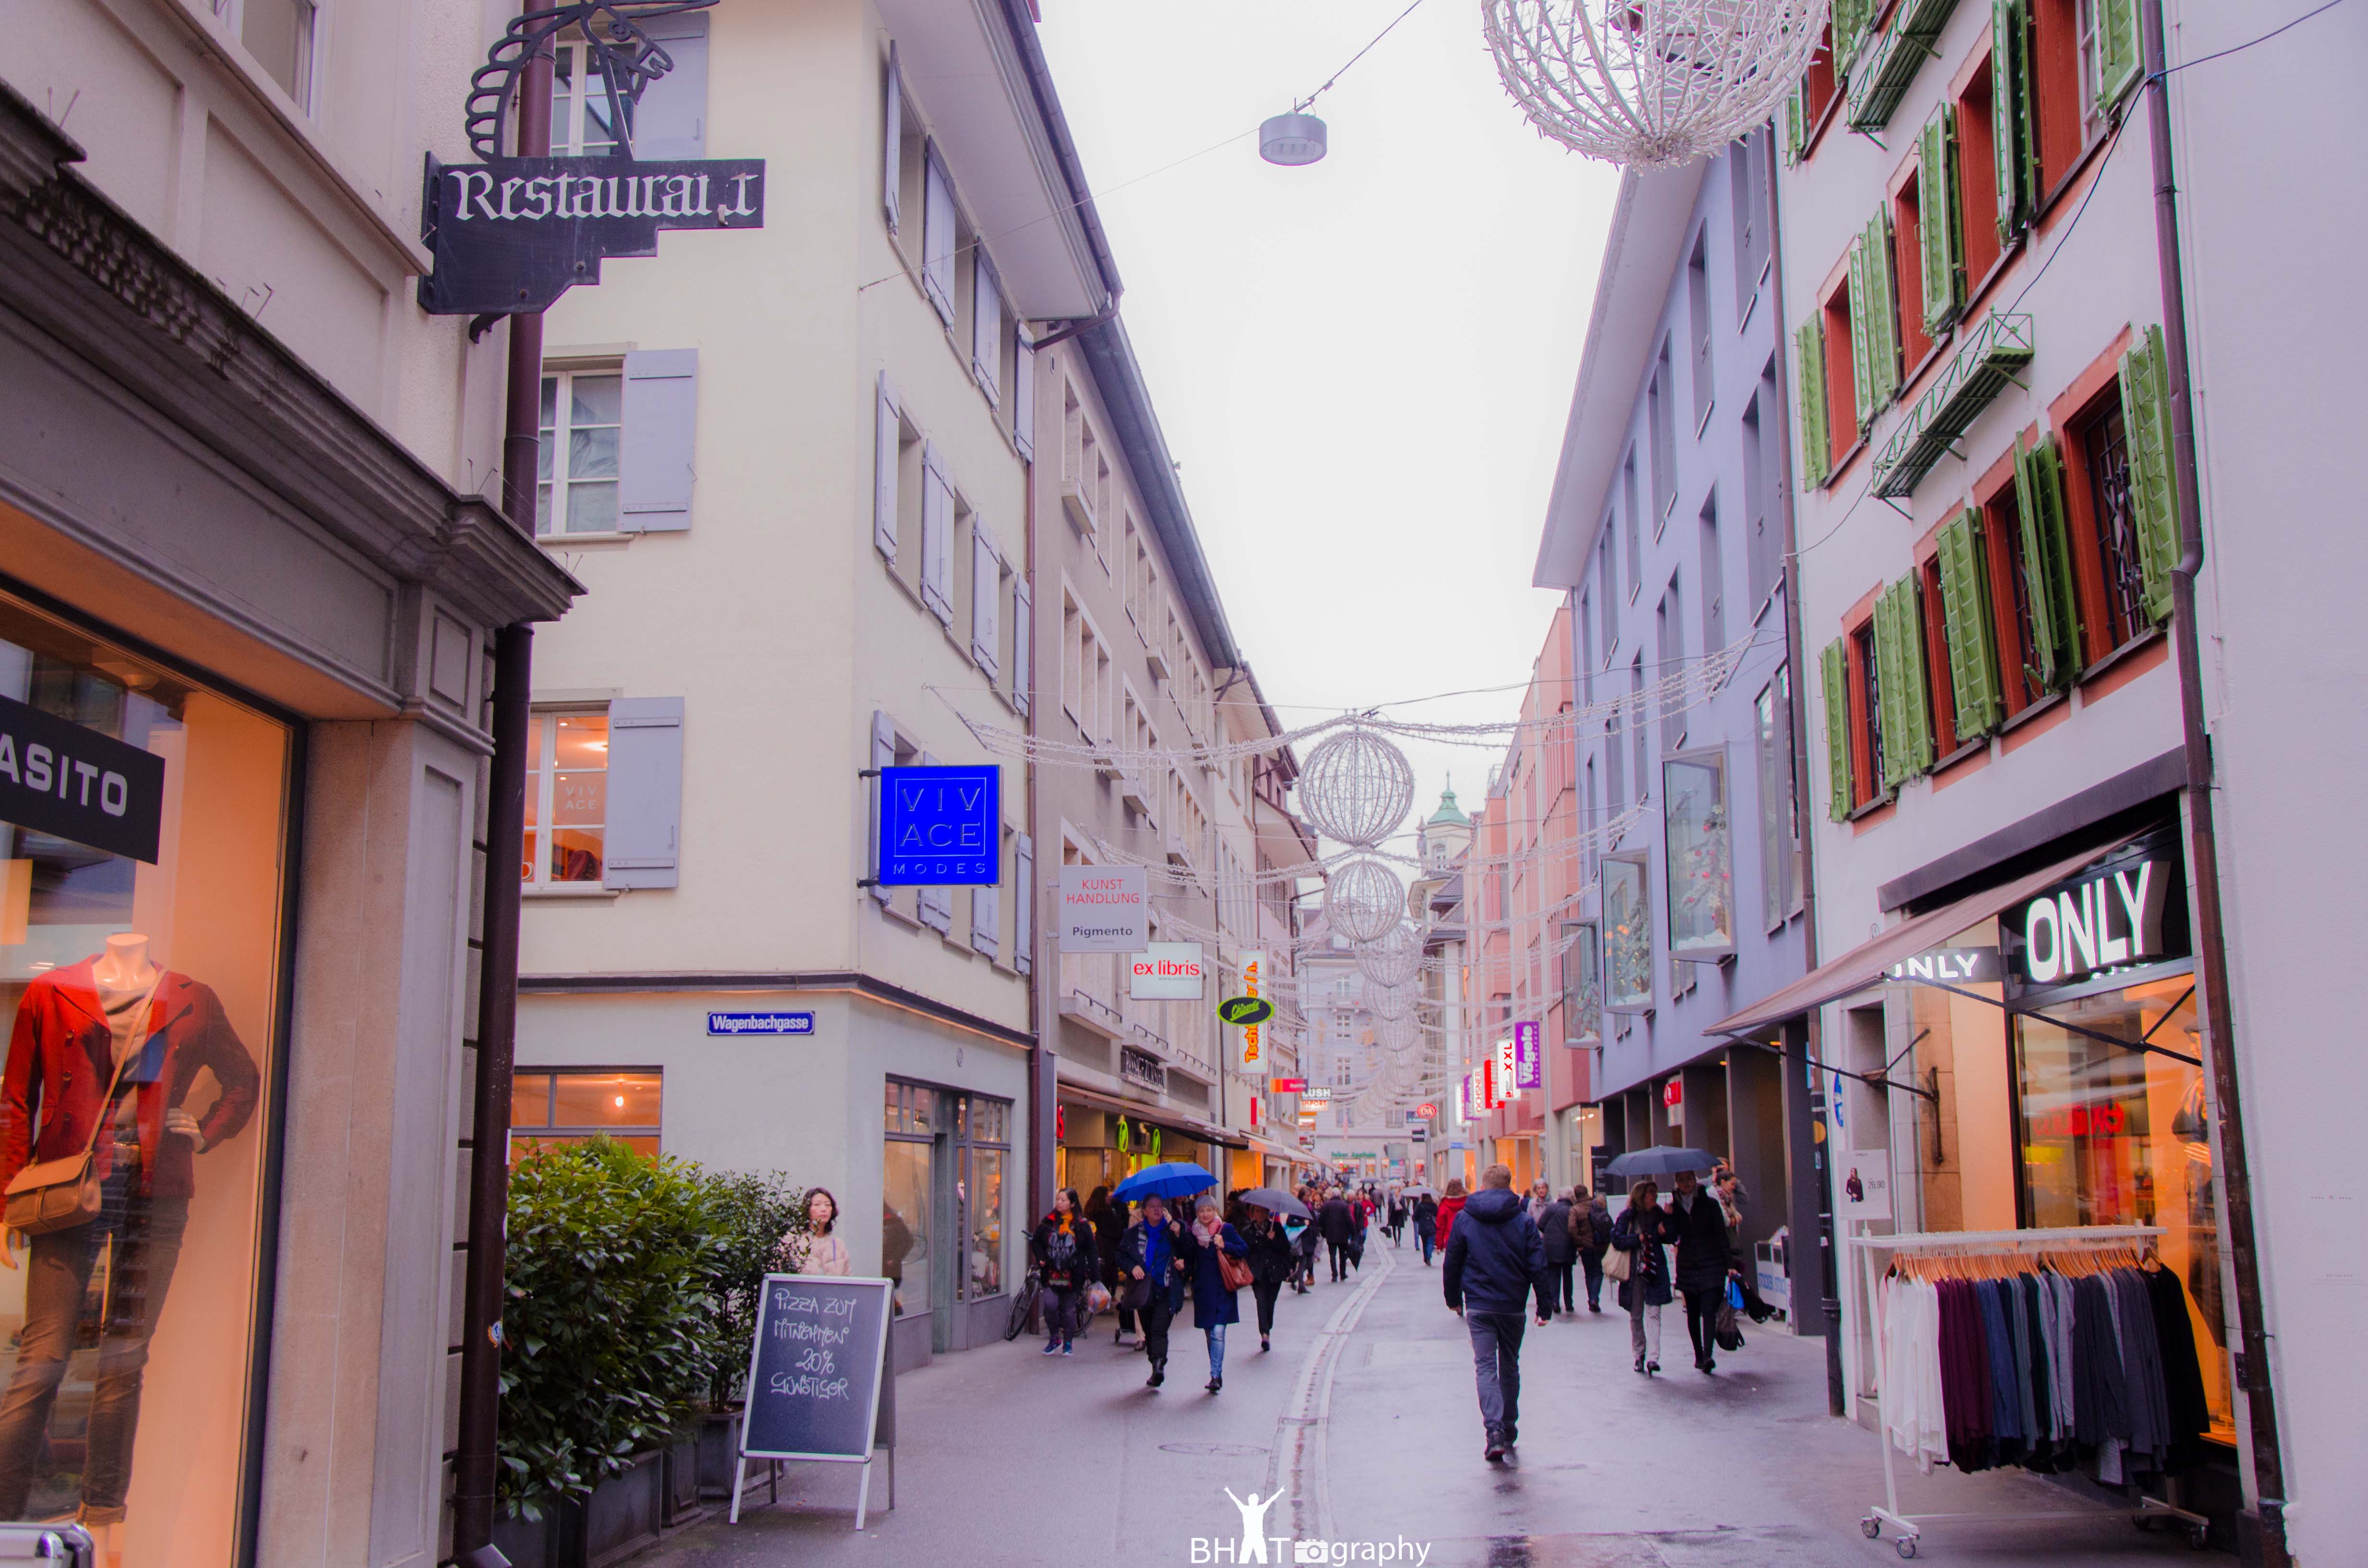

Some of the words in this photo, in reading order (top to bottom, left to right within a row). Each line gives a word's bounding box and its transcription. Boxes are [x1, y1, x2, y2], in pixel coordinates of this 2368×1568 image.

[565, 786, 597, 796] VIV
[901, 787, 981, 811] VIV
[565, 800, 596, 810] ACE
[900, 822, 981, 846] ACE
[893, 863, 986, 874] MODES
[1082, 879, 1124, 890] KUNST
[1066, 893, 1139, 904] HANDLUNG
[2026, 860, 2153, 983] ONLY
[1073, 926, 1133, 938] Pigmento
[1134, 963, 1154, 975] ex
[1159, 959, 1200, 976] libris
[712, 1015, 809, 1033] Wagenbachgasse
[1504, 1042, 1513, 1071] XXL
[1520, 1025, 1536, 1084] Vögele
[824, 1298, 857, 1323] ZUM
[796, 1348, 835, 1375] 20%
